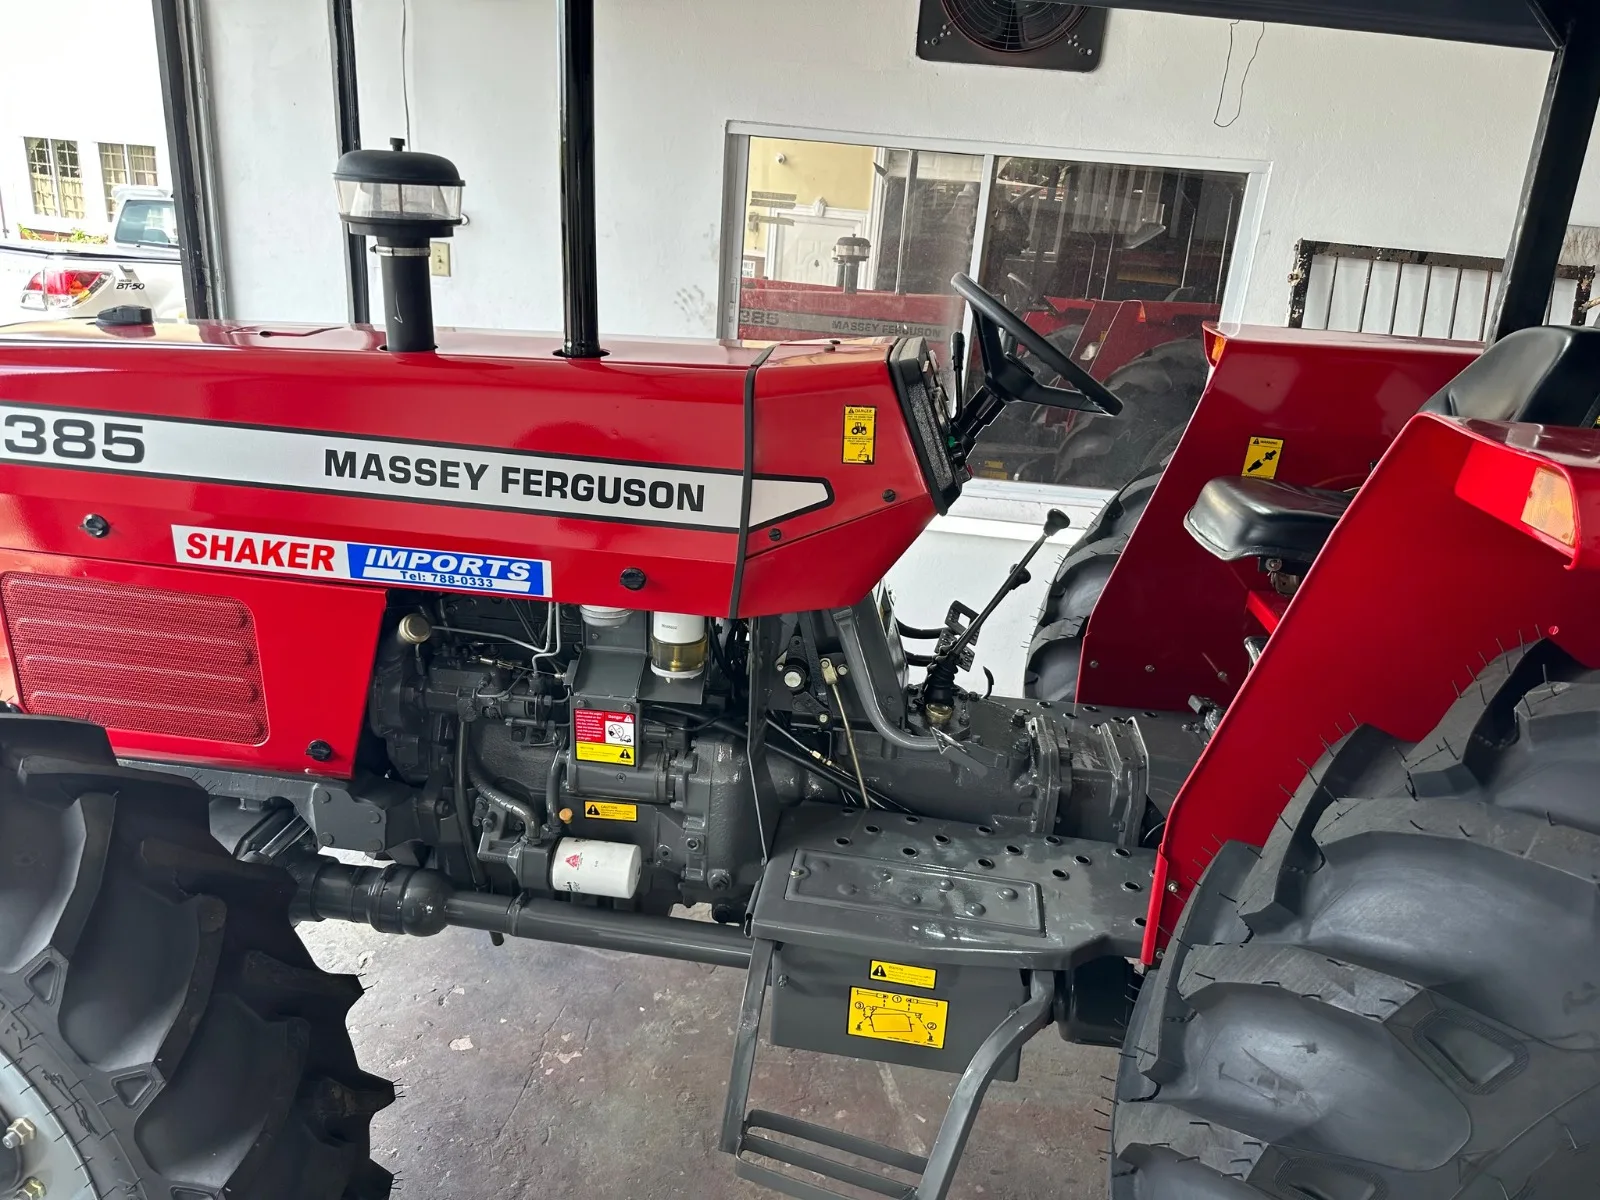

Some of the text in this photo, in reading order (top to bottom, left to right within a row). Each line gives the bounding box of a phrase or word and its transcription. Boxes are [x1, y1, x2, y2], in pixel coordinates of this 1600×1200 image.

[116, 282, 145, 290] BT-50
[832, 319, 880, 332] MASSEY
[882, 324, 941, 338] FERGUSON
[4, 414, 705, 513] 385 MASSEY FERGUSON
[186, 532, 531, 581] SHAKER IMPORTS
[400, 571, 493, 588] Tel: 788-0333
